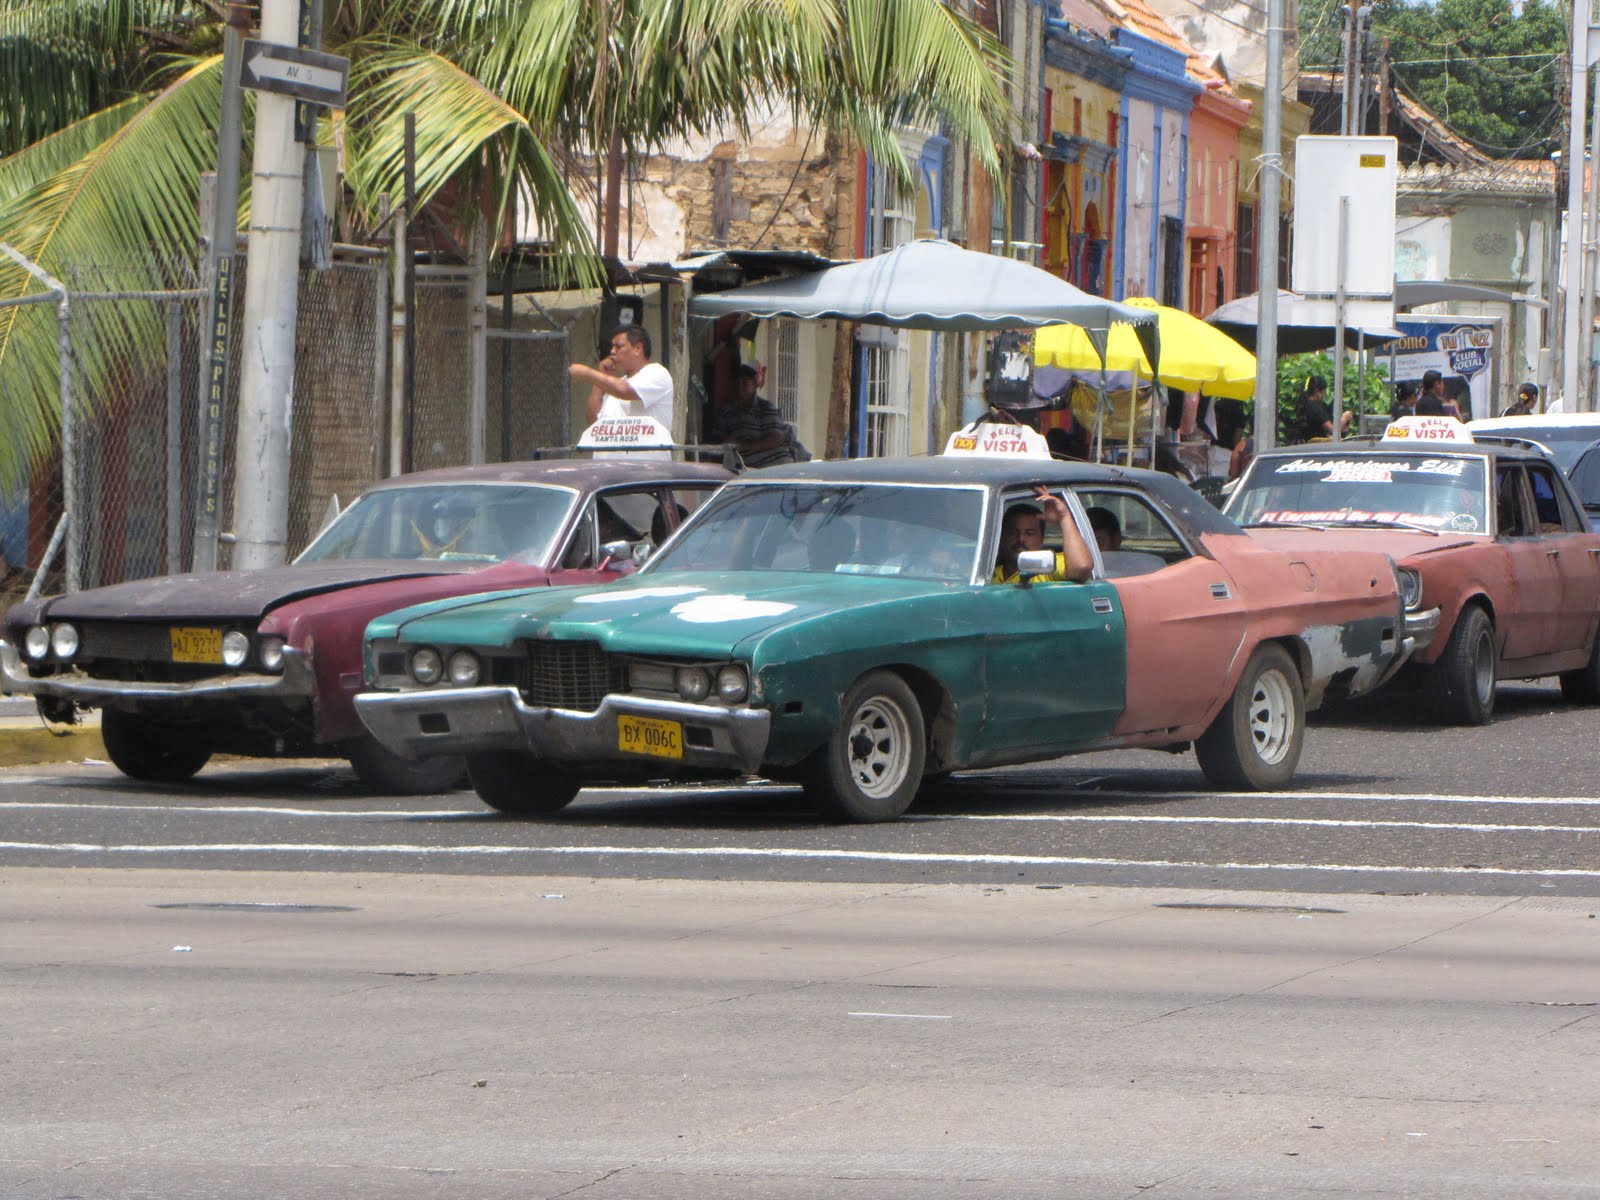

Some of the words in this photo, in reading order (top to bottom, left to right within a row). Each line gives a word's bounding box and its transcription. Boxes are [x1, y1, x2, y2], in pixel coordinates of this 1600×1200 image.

[1455, 351, 1477, 361] CLUB
[1452, 358, 1484, 371] SOCIAL
[1420, 419, 1449, 429] BELLA
[990, 427, 1023, 439] BELLA
[1415, 429, 1455, 439] VISTA
[954, 436, 977, 451] hoy
[983, 440, 1028, 453] VISTA
[623, 724, 640, 743] BX
[645, 727, 677, 749] 006C
